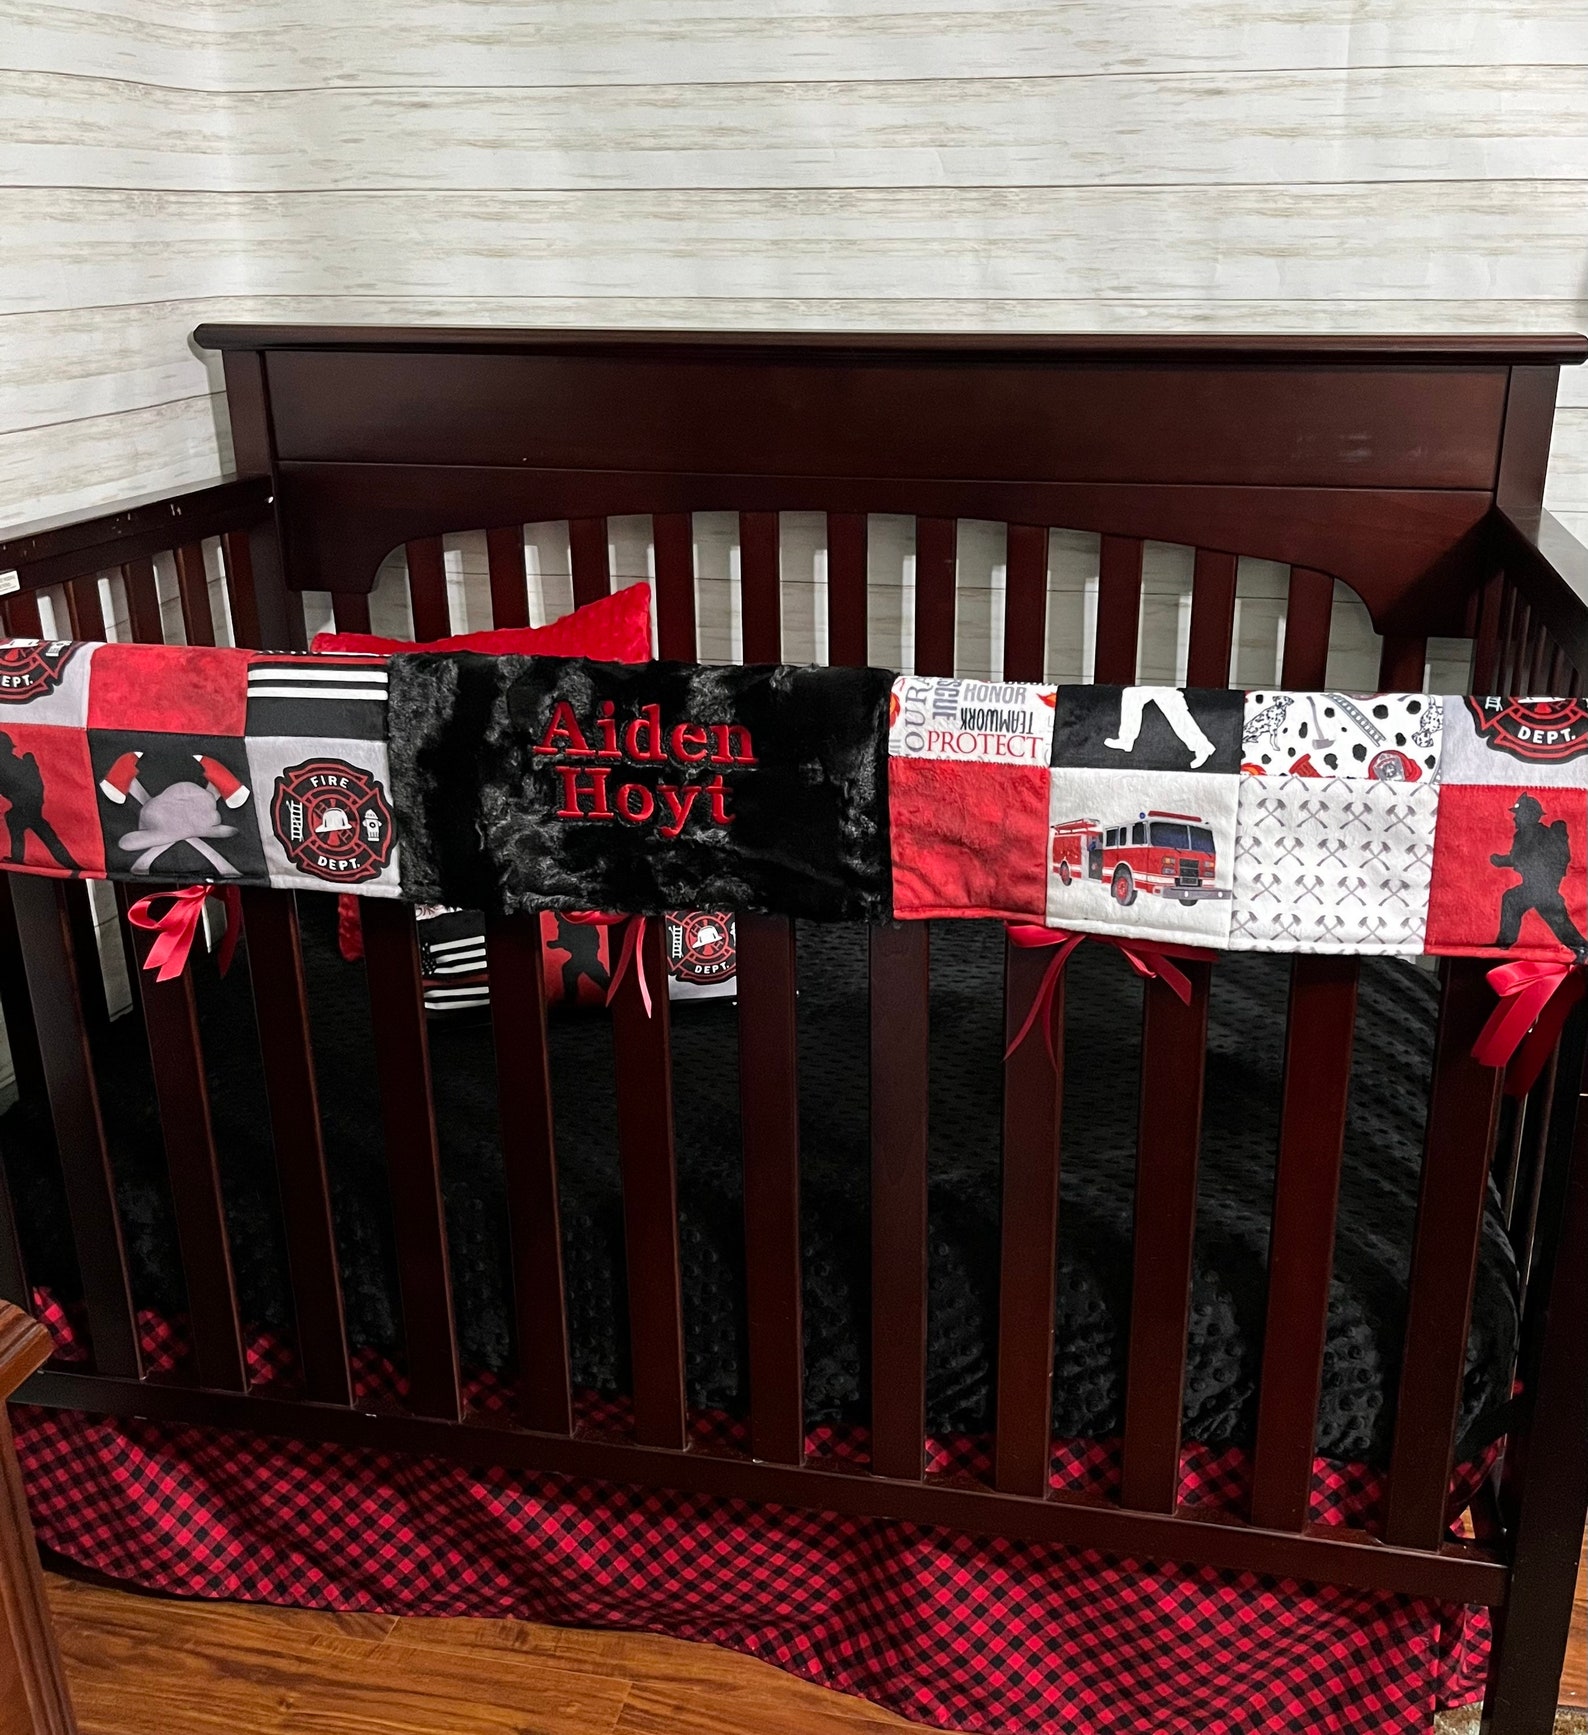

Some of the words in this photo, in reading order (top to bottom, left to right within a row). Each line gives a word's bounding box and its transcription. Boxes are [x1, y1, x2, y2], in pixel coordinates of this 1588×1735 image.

[0, 674, 34, 688] EPT.
[963, 683, 1027, 705] HONOR
[960, 707, 1034, 735] TEAMWORK
[532, 701, 759, 764] Aiden
[1517, 725, 1577, 745] DEPT.
[926, 730, 1044, 759] PROTECT
[310, 775, 350, 789] FIRE
[555, 766, 735, 838] Hoyt
[317, 855, 361, 871] DEPT.
[694, 961, 730, 974] DEPT.
